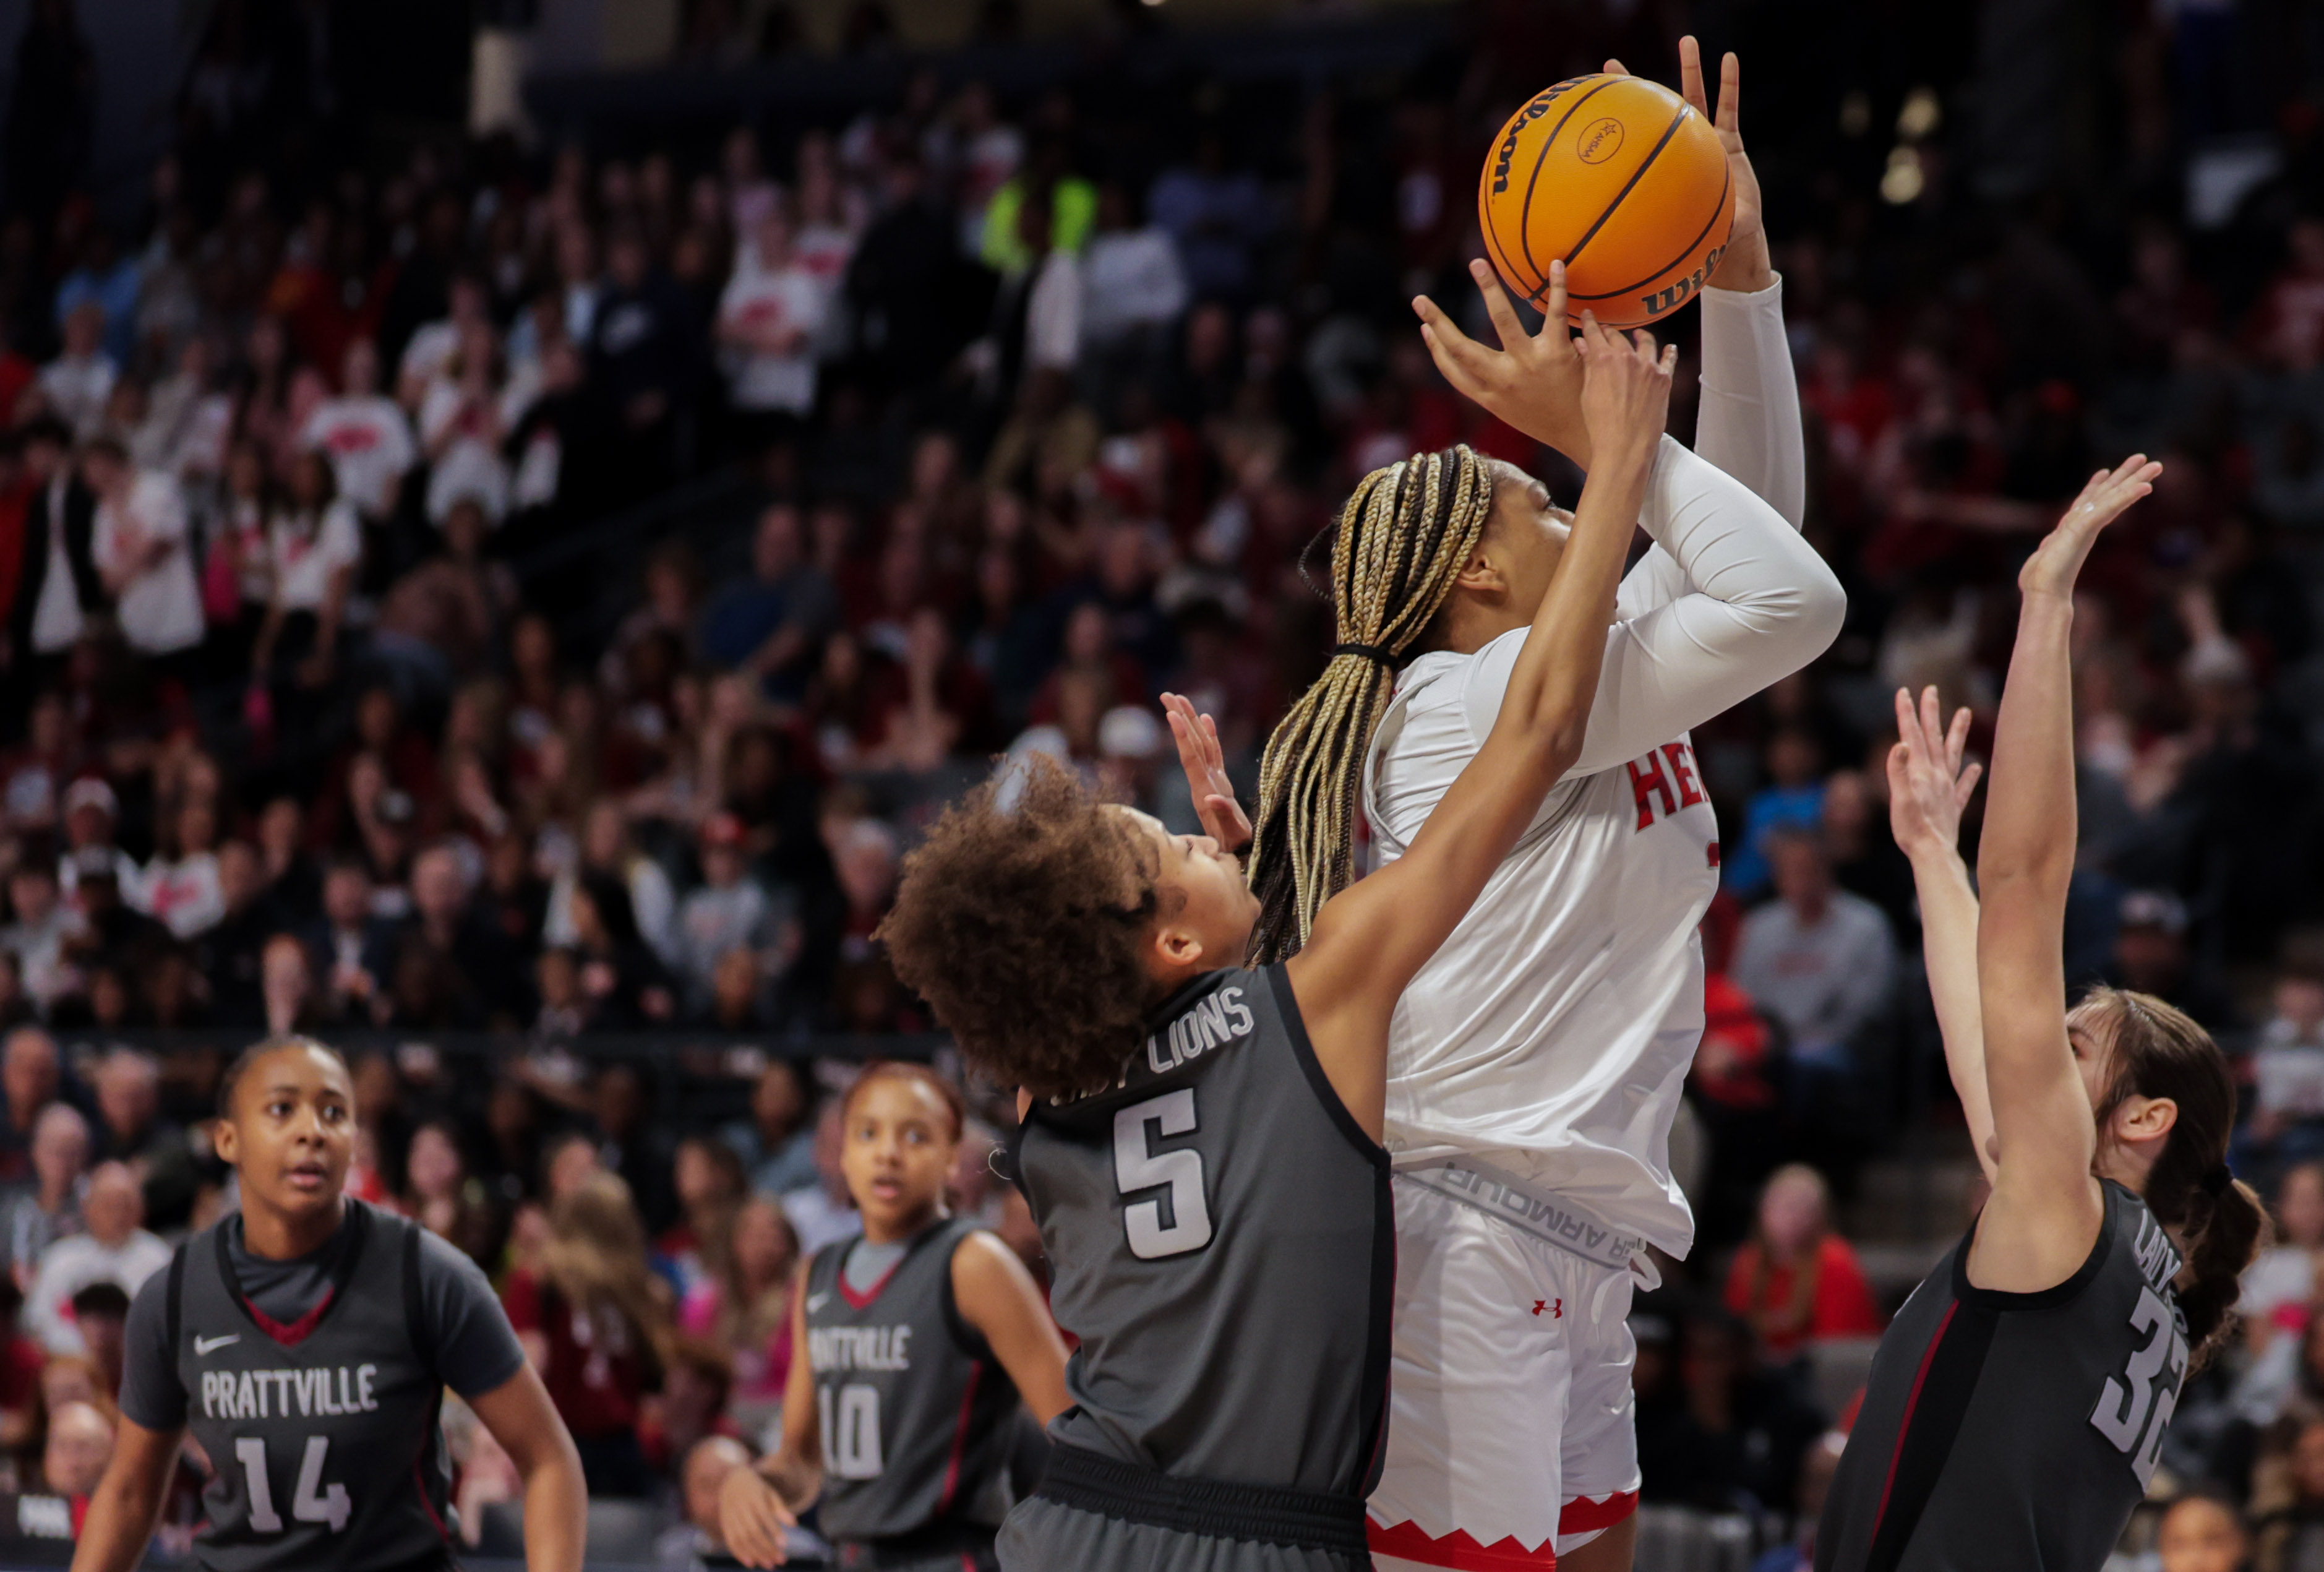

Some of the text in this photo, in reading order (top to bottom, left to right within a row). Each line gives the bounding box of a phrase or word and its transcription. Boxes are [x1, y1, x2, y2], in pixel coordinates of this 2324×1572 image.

[1626, 742, 1712, 833] HE
[1147, 986, 1254, 1074] LIONS
[1113, 1088, 1212, 1260] 5
[1441, 1162, 1608, 1248] ARMOUR
[2135, 1208, 2182, 1294] LADY
[202, 1363, 379, 1419] PRATTVILLE
[818, 1384, 884, 1479] 10
[2090, 1284, 2189, 1495] 32
[235, 1435, 352, 1533] 14
